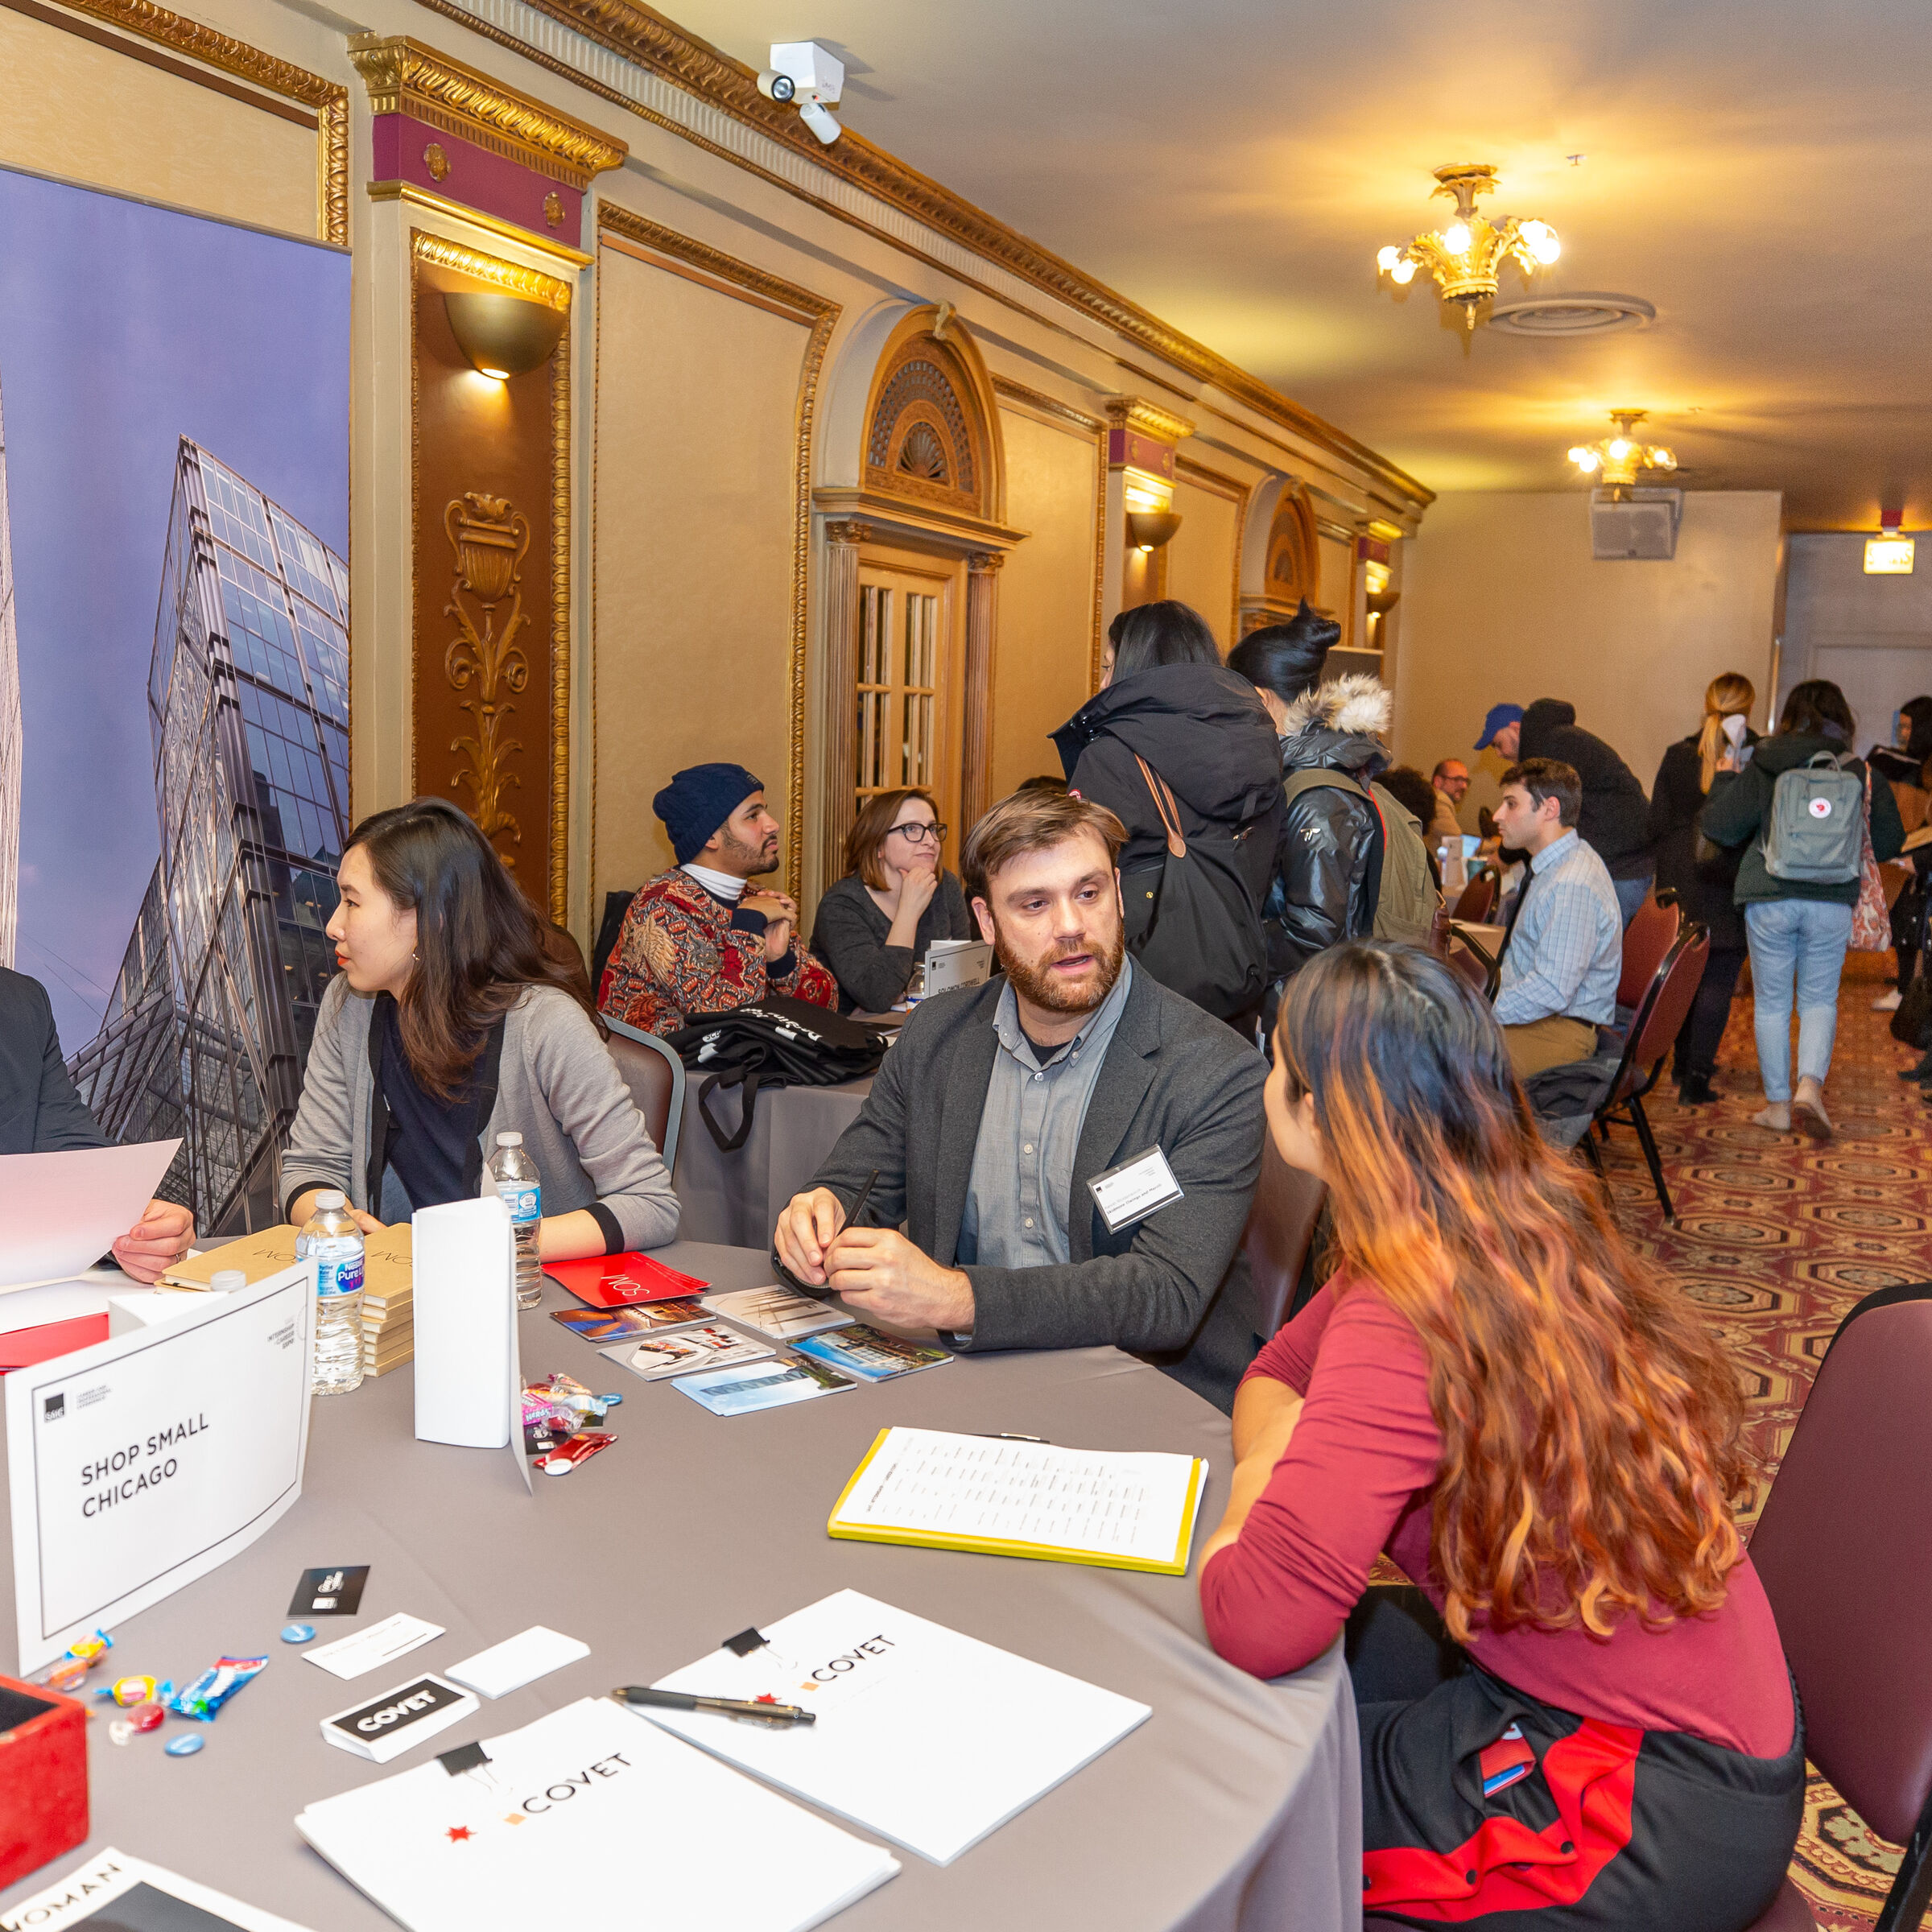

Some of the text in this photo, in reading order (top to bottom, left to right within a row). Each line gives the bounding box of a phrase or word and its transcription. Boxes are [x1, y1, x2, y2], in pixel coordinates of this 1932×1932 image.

[601, 1274, 650, 1296] SOM
[82, 1412, 209, 1485] SHOP SMALL
[83, 1459, 177, 1517] CHICAGO
[811, 1634, 895, 1682] COVET
[357, 1689, 437, 1732] COVET
[522, 1752, 631, 1814] COVET
